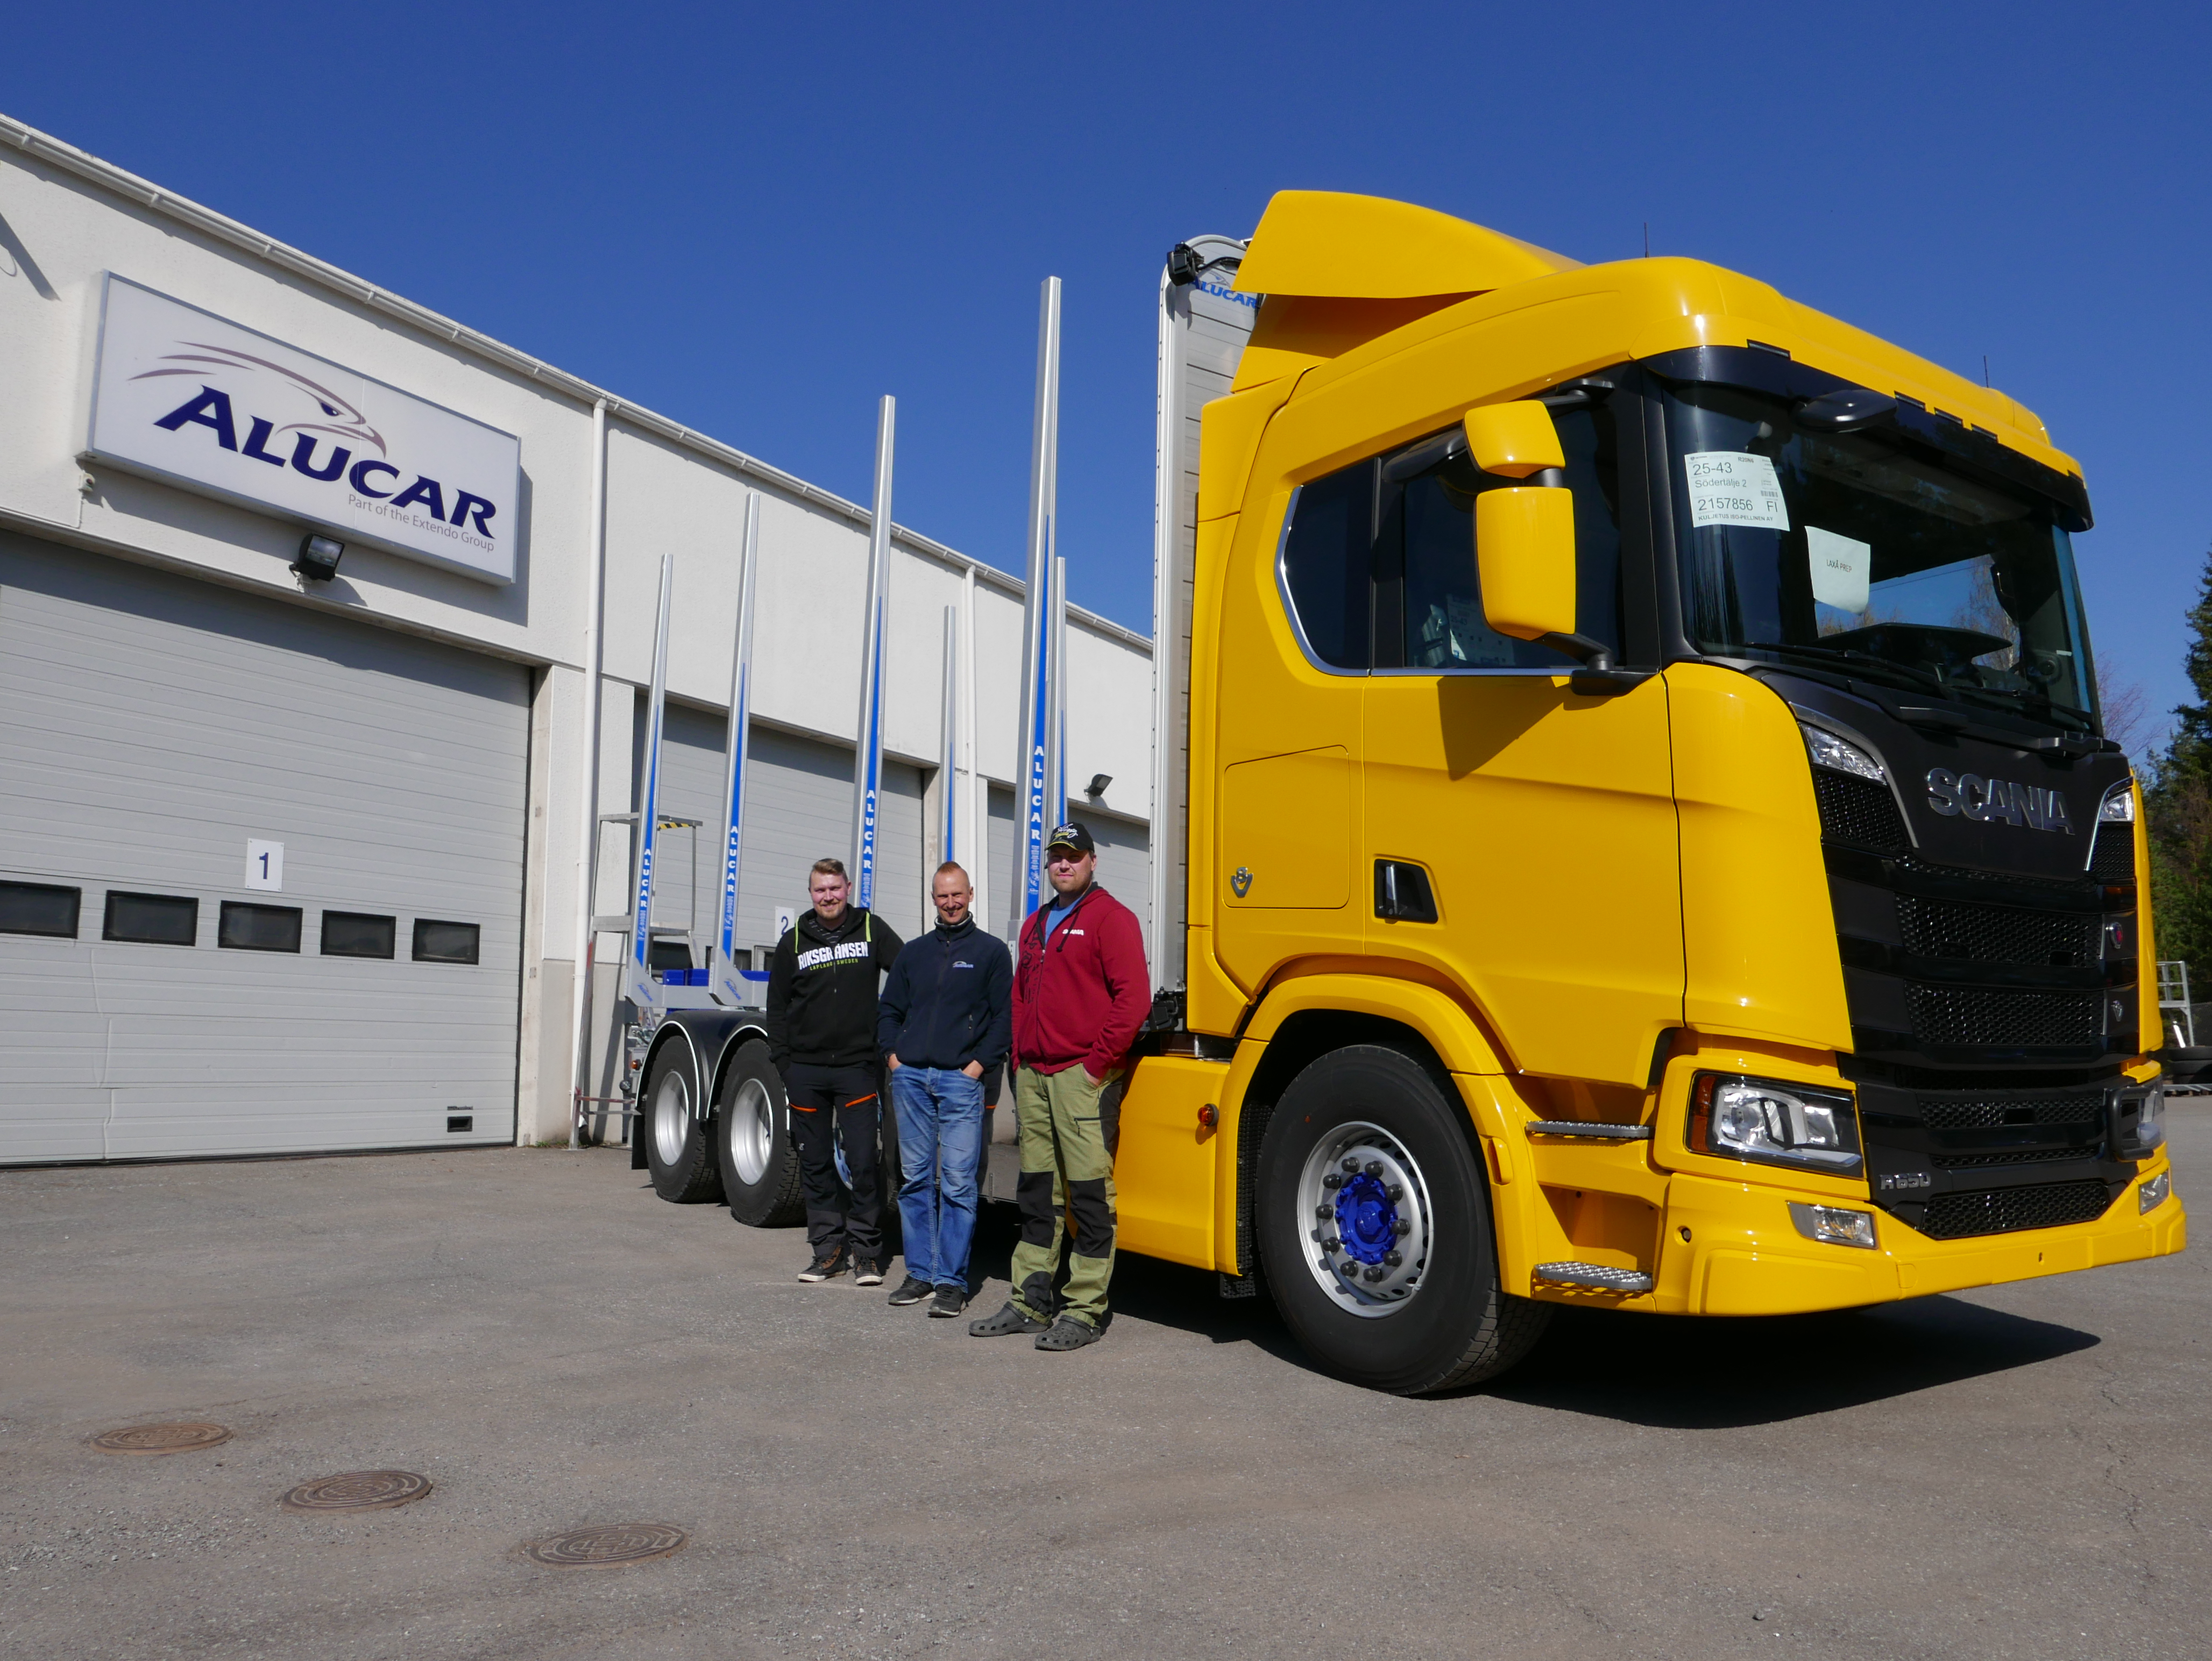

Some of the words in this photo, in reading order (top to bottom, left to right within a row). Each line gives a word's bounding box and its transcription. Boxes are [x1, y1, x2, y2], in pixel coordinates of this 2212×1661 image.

[153, 384, 497, 540] ALUCAR
[1692, 462, 1732, 475] 25-43
[1695, 478, 1740, 488] Södertälje
[1742, 479, 1747, 487] 2
[349, 494, 372, 512] Part
[376, 505, 388, 516] of
[391, 508, 409, 523] the
[413, 515, 458, 540] Extendo
[461, 531, 494, 553] Group
[1698, 498, 1753, 511] 2157856
[1767, 501, 1778, 513] FI
[1698, 513, 1729, 521] KULJETUS
[1031, 746, 1044, 840] ALUCAR
[1927, 768, 2075, 835] SCANIA
[863, 789, 876, 869] ALUCAR
[259, 852, 269, 879] 1
[640, 848, 651, 907] ALUCAR
[727, 826, 739, 892] ALUCAR
[781, 915, 789, 935] 2
